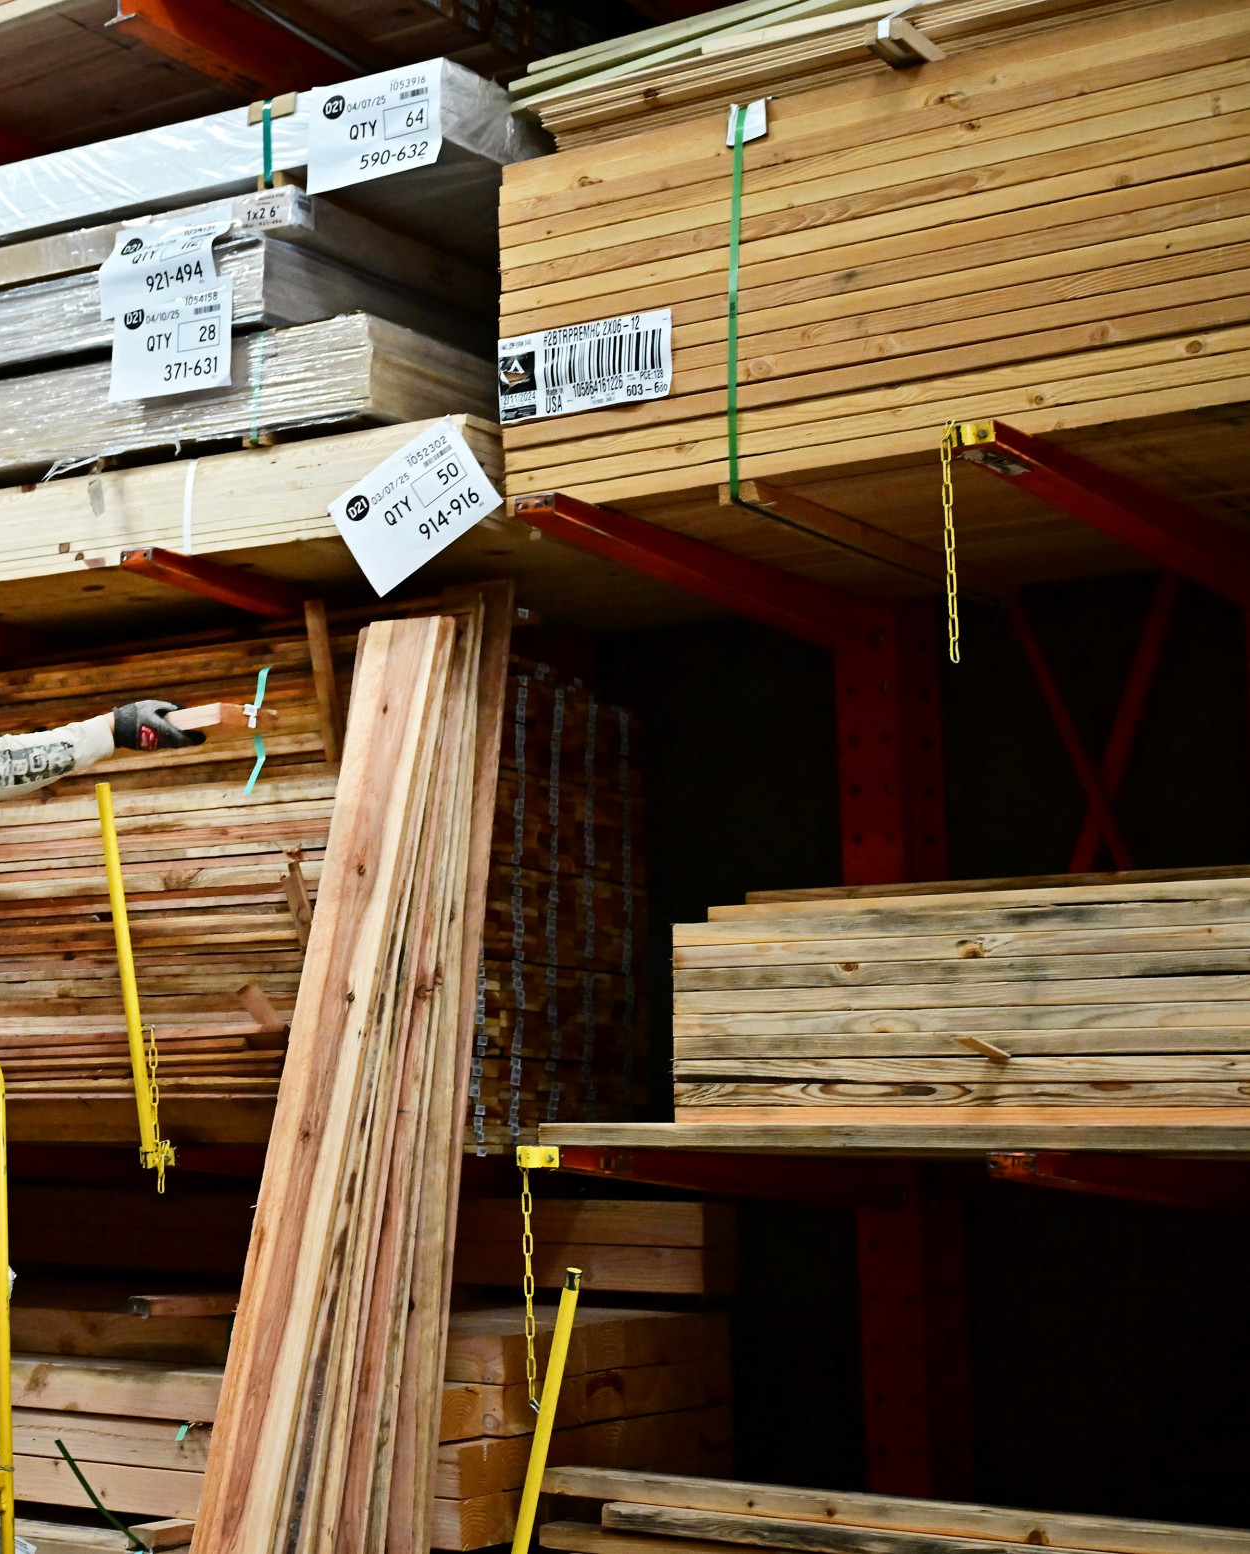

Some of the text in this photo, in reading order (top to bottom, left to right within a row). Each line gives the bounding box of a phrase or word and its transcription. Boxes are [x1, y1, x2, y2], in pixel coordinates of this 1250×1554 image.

[390, 75, 427, 91] 1053916
[324, 94, 387, 116] D21 04/07/25
[349, 108, 425, 141] QTY 64
[359, 140, 429, 170] 590-632
[145, 260, 204, 293] 921-494
[185, 291, 218, 306] 1054158
[125, 309, 180, 325] D21 04/10/25
[146, 324, 216, 352] QTY 28
[163, 356, 218, 382] 371-631
[545, 394, 563, 414] USA
[406, 435, 448, 467] 1052302
[347, 472, 410, 521] D21 03/07/25
[384, 462, 459, 526] QTY 50
[418, 487, 480, 540] 914-916
